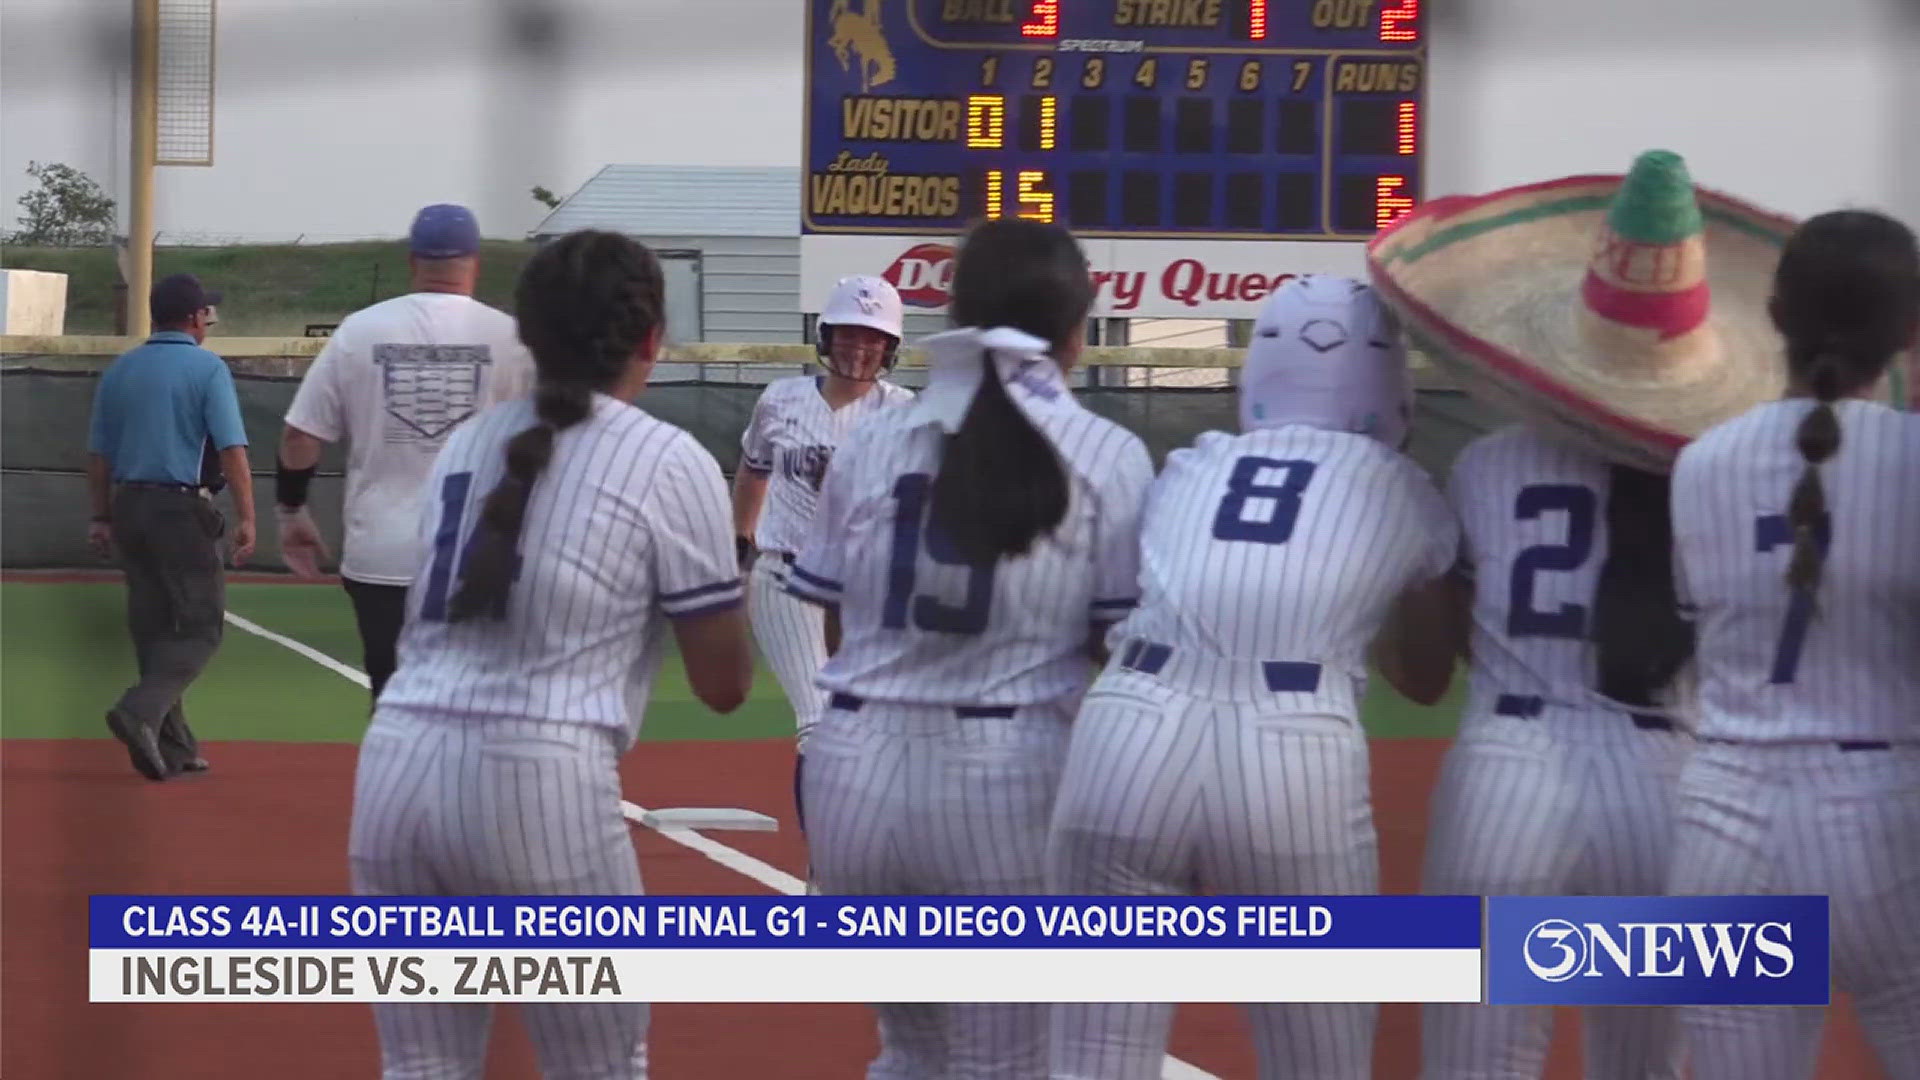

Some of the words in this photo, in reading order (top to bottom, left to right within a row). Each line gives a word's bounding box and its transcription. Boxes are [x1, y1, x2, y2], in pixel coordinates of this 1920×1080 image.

[942, 0, 1014, 21] BALL
[1022, 0, 1058, 36] 3
[1114, 0, 1220, 26] STRIKE
[1250, 0, 1265, 39] 1
[1312, 0, 1373, 27] OUT
[1380, 0, 1417, 41] 2
[1057, 39, 1144, 52] SPECTRUM
[982, 57, 997, 86] 1
[1032, 58, 1052, 87] 2
[1083, 59, 1103, 88] 3
[1136, 59, 1156, 87] 4
[1187, 60, 1207, 89] 5
[1240, 61, 1261, 90] 6
[1292, 62, 1311, 91] 7
[1336, 64, 1418, 91] RUNS
[843, 98, 961, 139] VISITOR
[1040, 97, 1056, 149] 1
[1399, 103, 1414, 154] 1
[827, 151, 889, 178] Lady
[812, 174, 960, 215] VAQUEROS
[1161, 258, 1298, 307] Que
[1212, 457, 1317, 545] 8
[1508, 484, 1598, 638] 2
